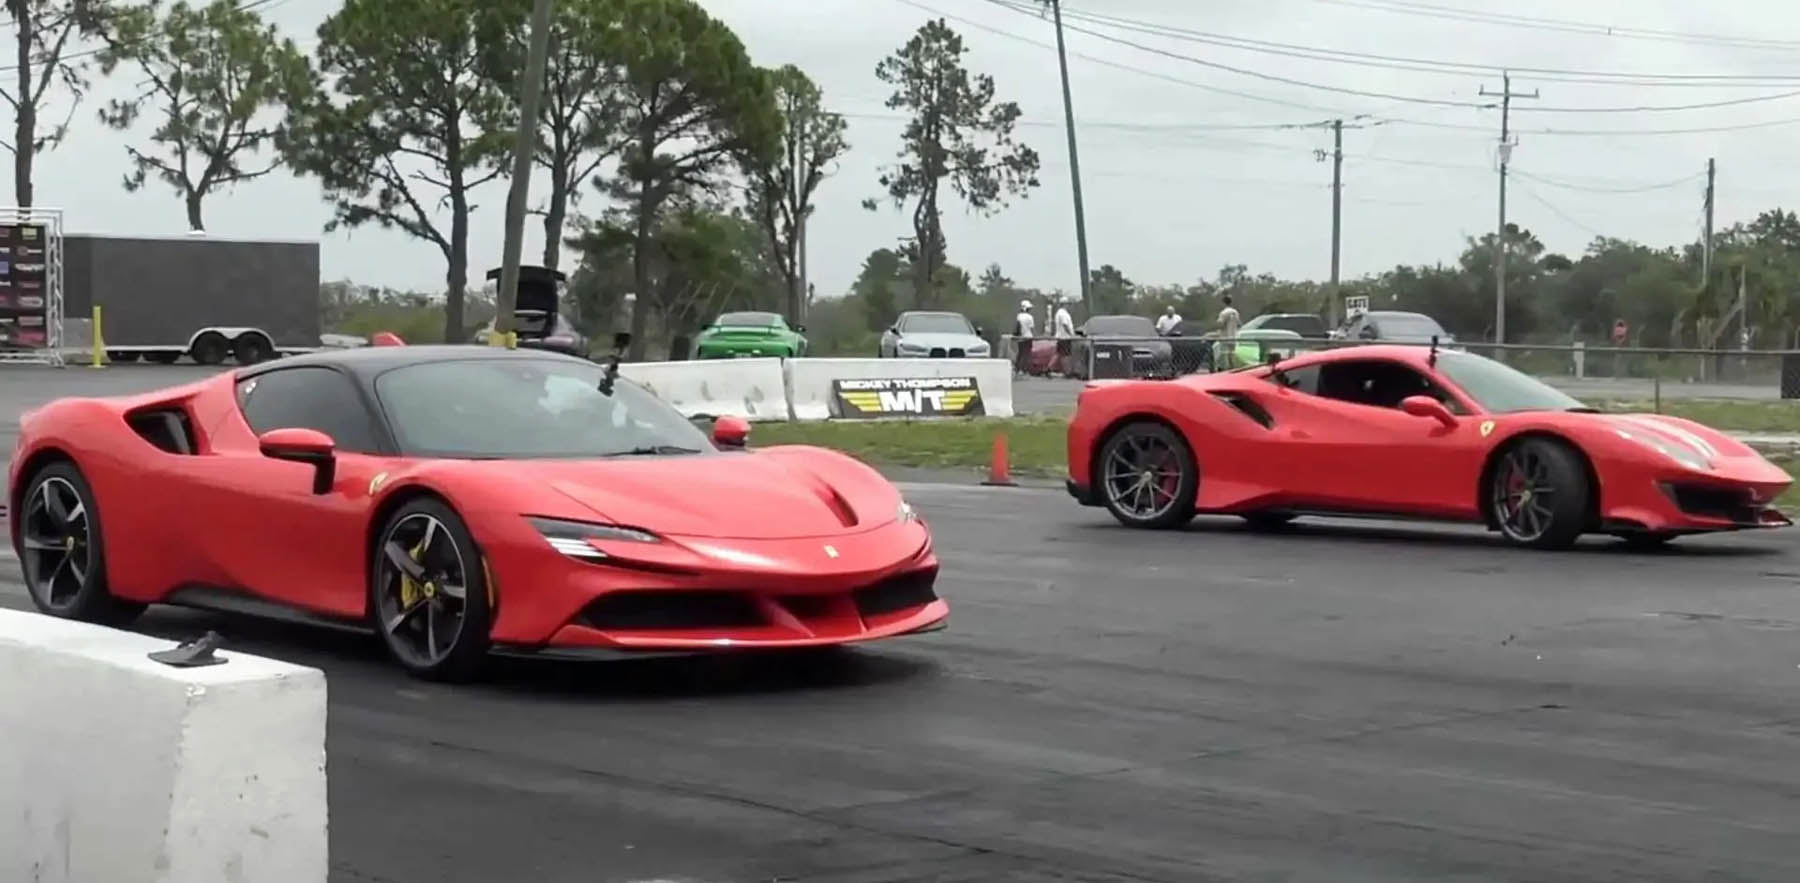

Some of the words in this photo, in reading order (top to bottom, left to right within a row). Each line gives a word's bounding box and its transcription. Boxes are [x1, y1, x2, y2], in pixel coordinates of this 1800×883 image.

[840, 380, 891, 390] MICKEY
[892, 378, 971, 389] THOMPSON
[879, 389, 945, 413] M/T
